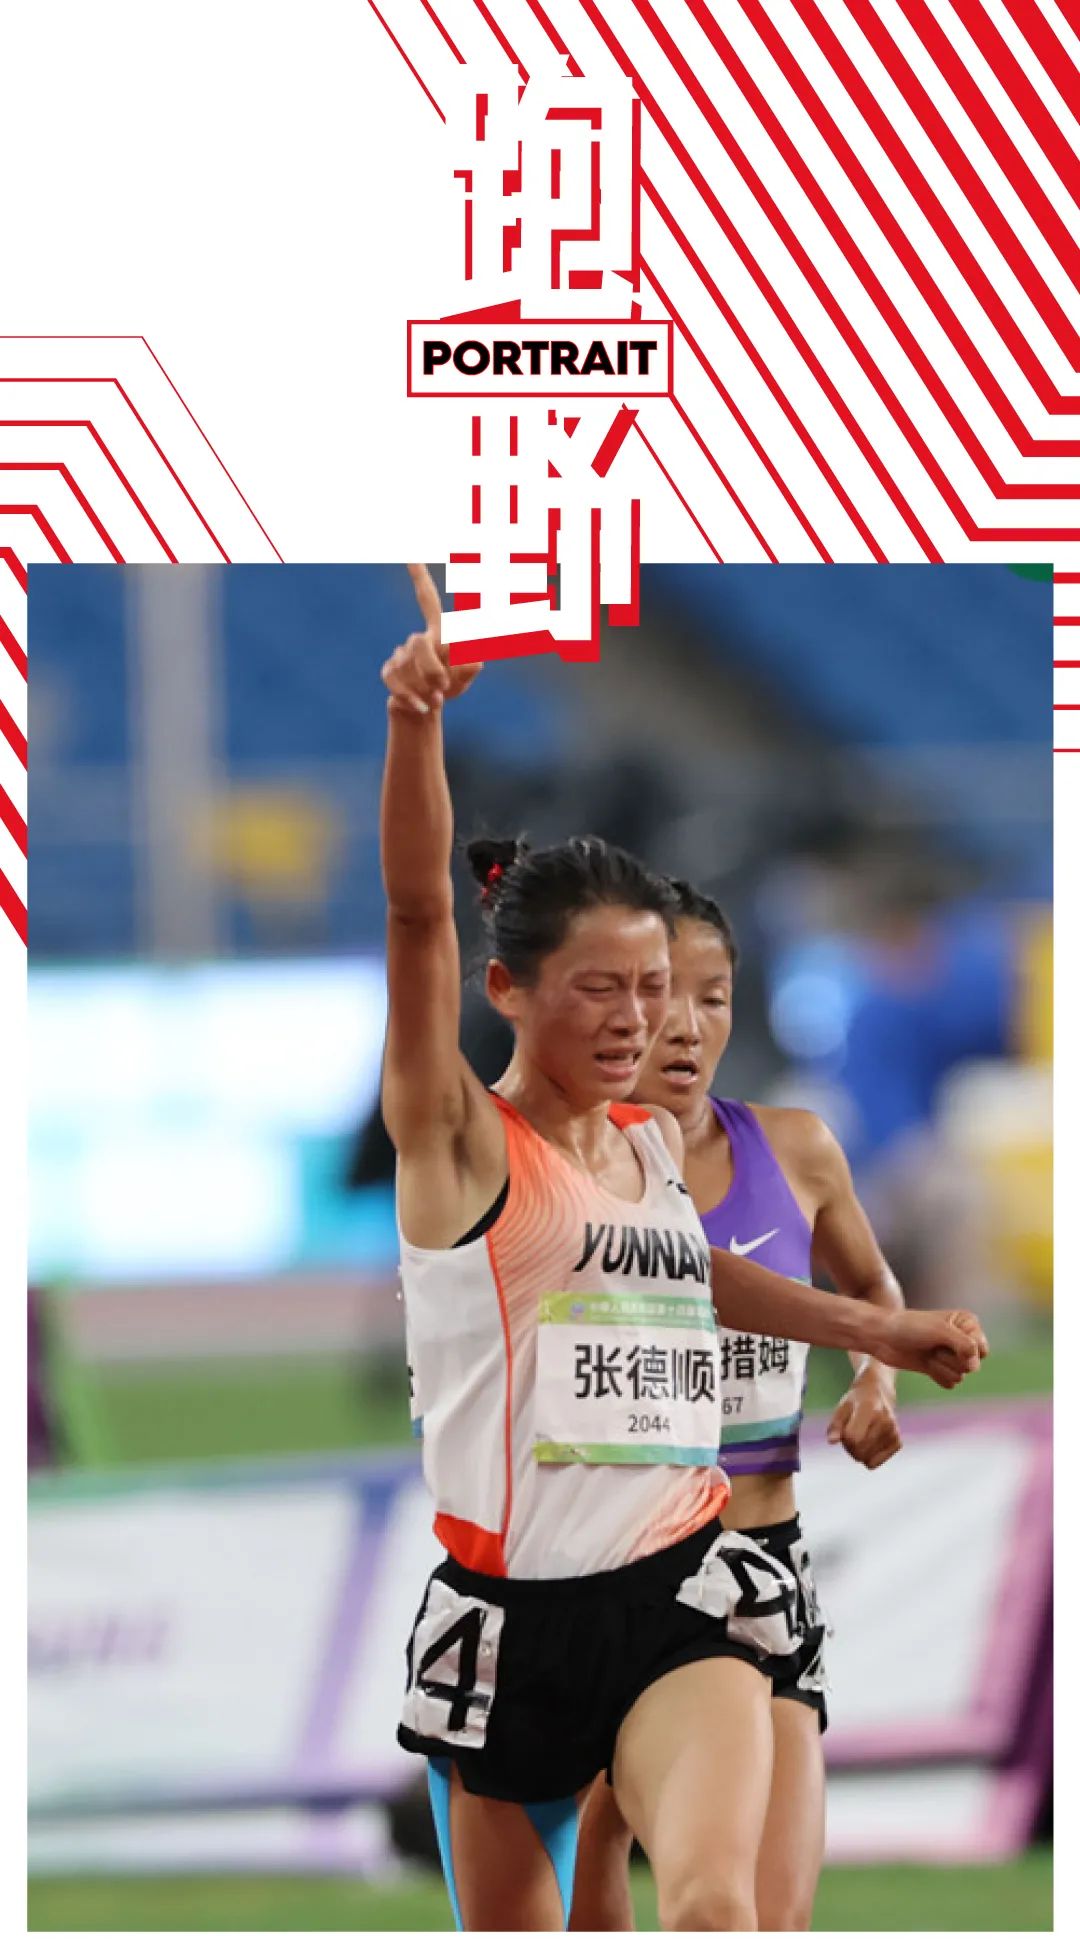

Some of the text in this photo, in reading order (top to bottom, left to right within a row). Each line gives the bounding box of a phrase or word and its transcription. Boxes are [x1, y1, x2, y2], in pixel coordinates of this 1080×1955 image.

[575, 1344, 715, 1403] 张德顺
[717, 1546, 797, 1640] 4
[416, 1607, 491, 1732] 4
